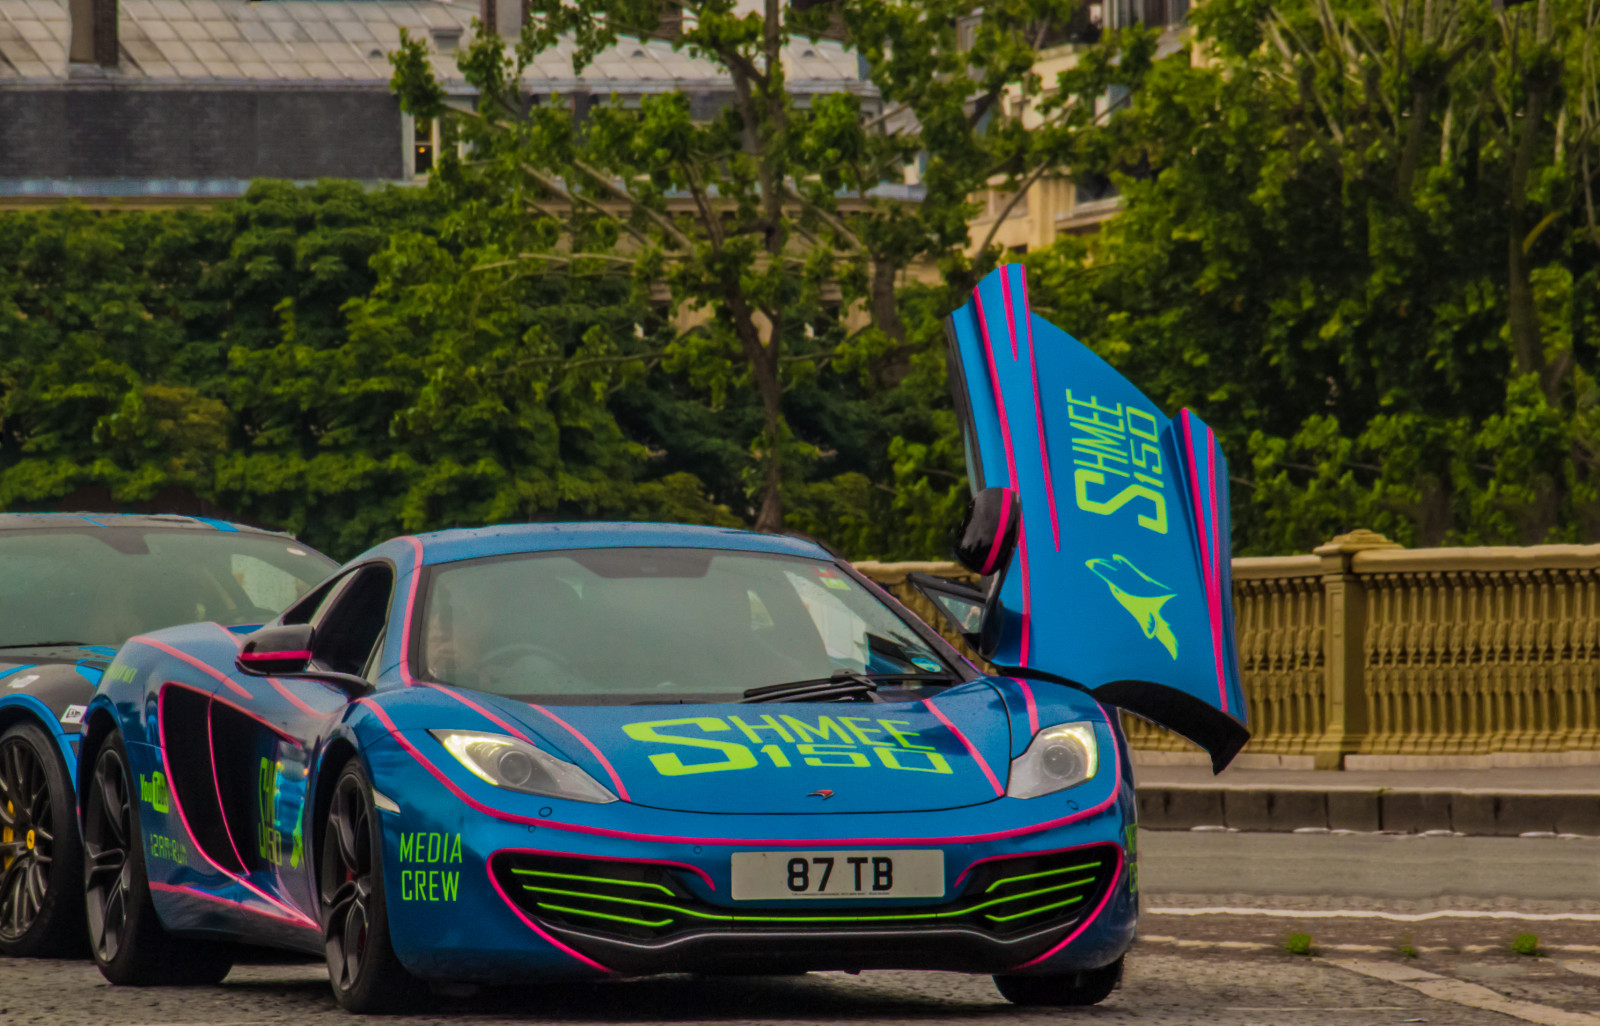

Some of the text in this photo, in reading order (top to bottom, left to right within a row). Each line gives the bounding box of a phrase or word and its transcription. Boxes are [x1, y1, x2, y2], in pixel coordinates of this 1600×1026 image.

[760, 744, 954, 775] 150
[400, 832, 463, 863] MEDIA
[401, 870, 460, 902] CREW
[787, 857, 893, 892] 87 TB
